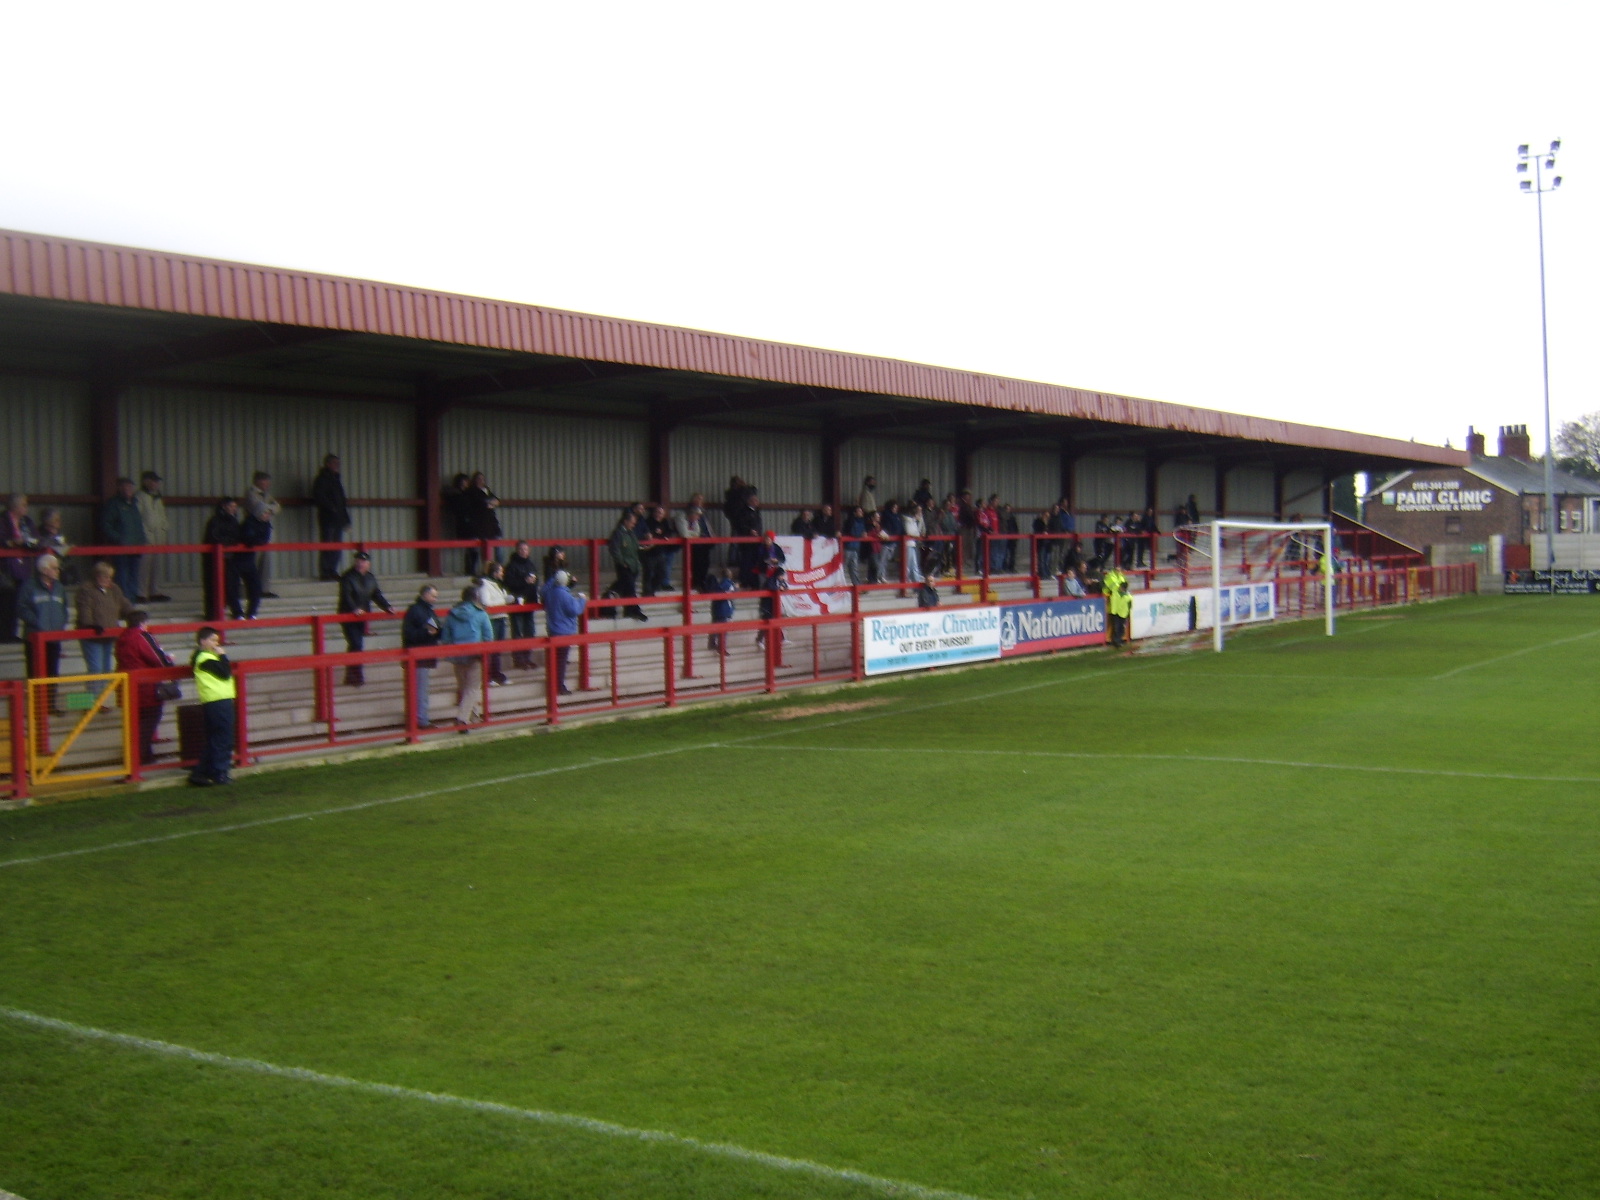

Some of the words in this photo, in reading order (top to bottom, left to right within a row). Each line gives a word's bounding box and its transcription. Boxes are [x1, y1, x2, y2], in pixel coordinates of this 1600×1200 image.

[1396, 491, 1433, 505] PAIN
[1437, 490, 1492, 504] CLINIC
[872, 619, 930, 645] Reporter
[942, 610, 998, 634] Chronicle
[1017, 604, 1104, 640] Nationwide
[900, 641, 913, 653] OUT
[915, 639, 937, 651] EVERY
